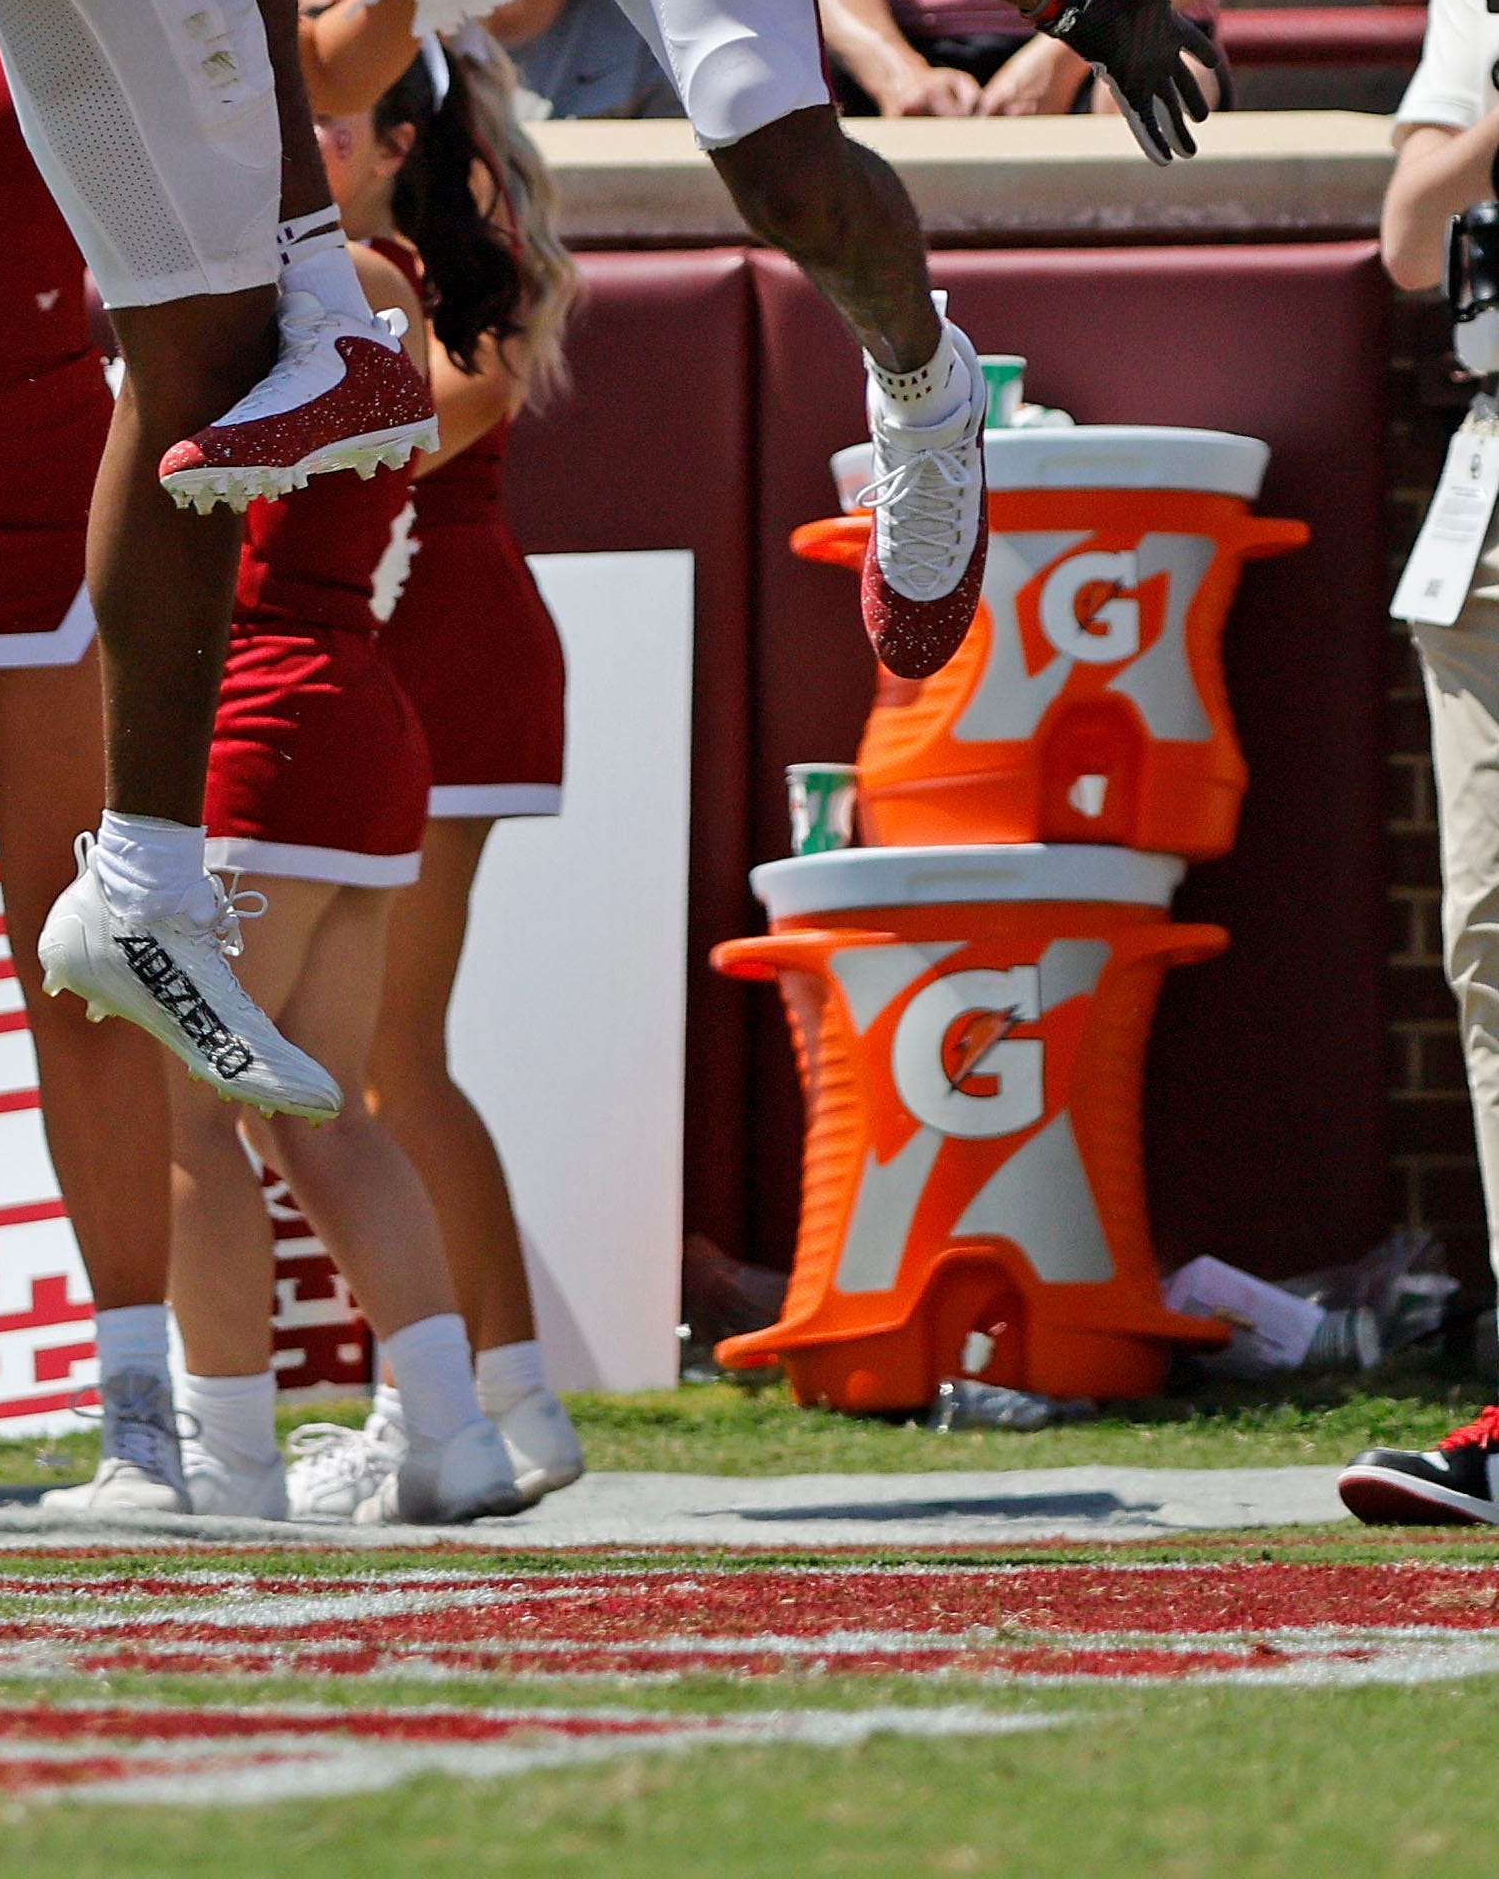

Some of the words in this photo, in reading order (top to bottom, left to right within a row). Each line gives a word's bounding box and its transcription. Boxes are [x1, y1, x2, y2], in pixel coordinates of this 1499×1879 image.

[1040, 550, 1141, 664] G
[113, 935, 254, 1080] ADIZERO
[892, 963, 1045, 1140] G
